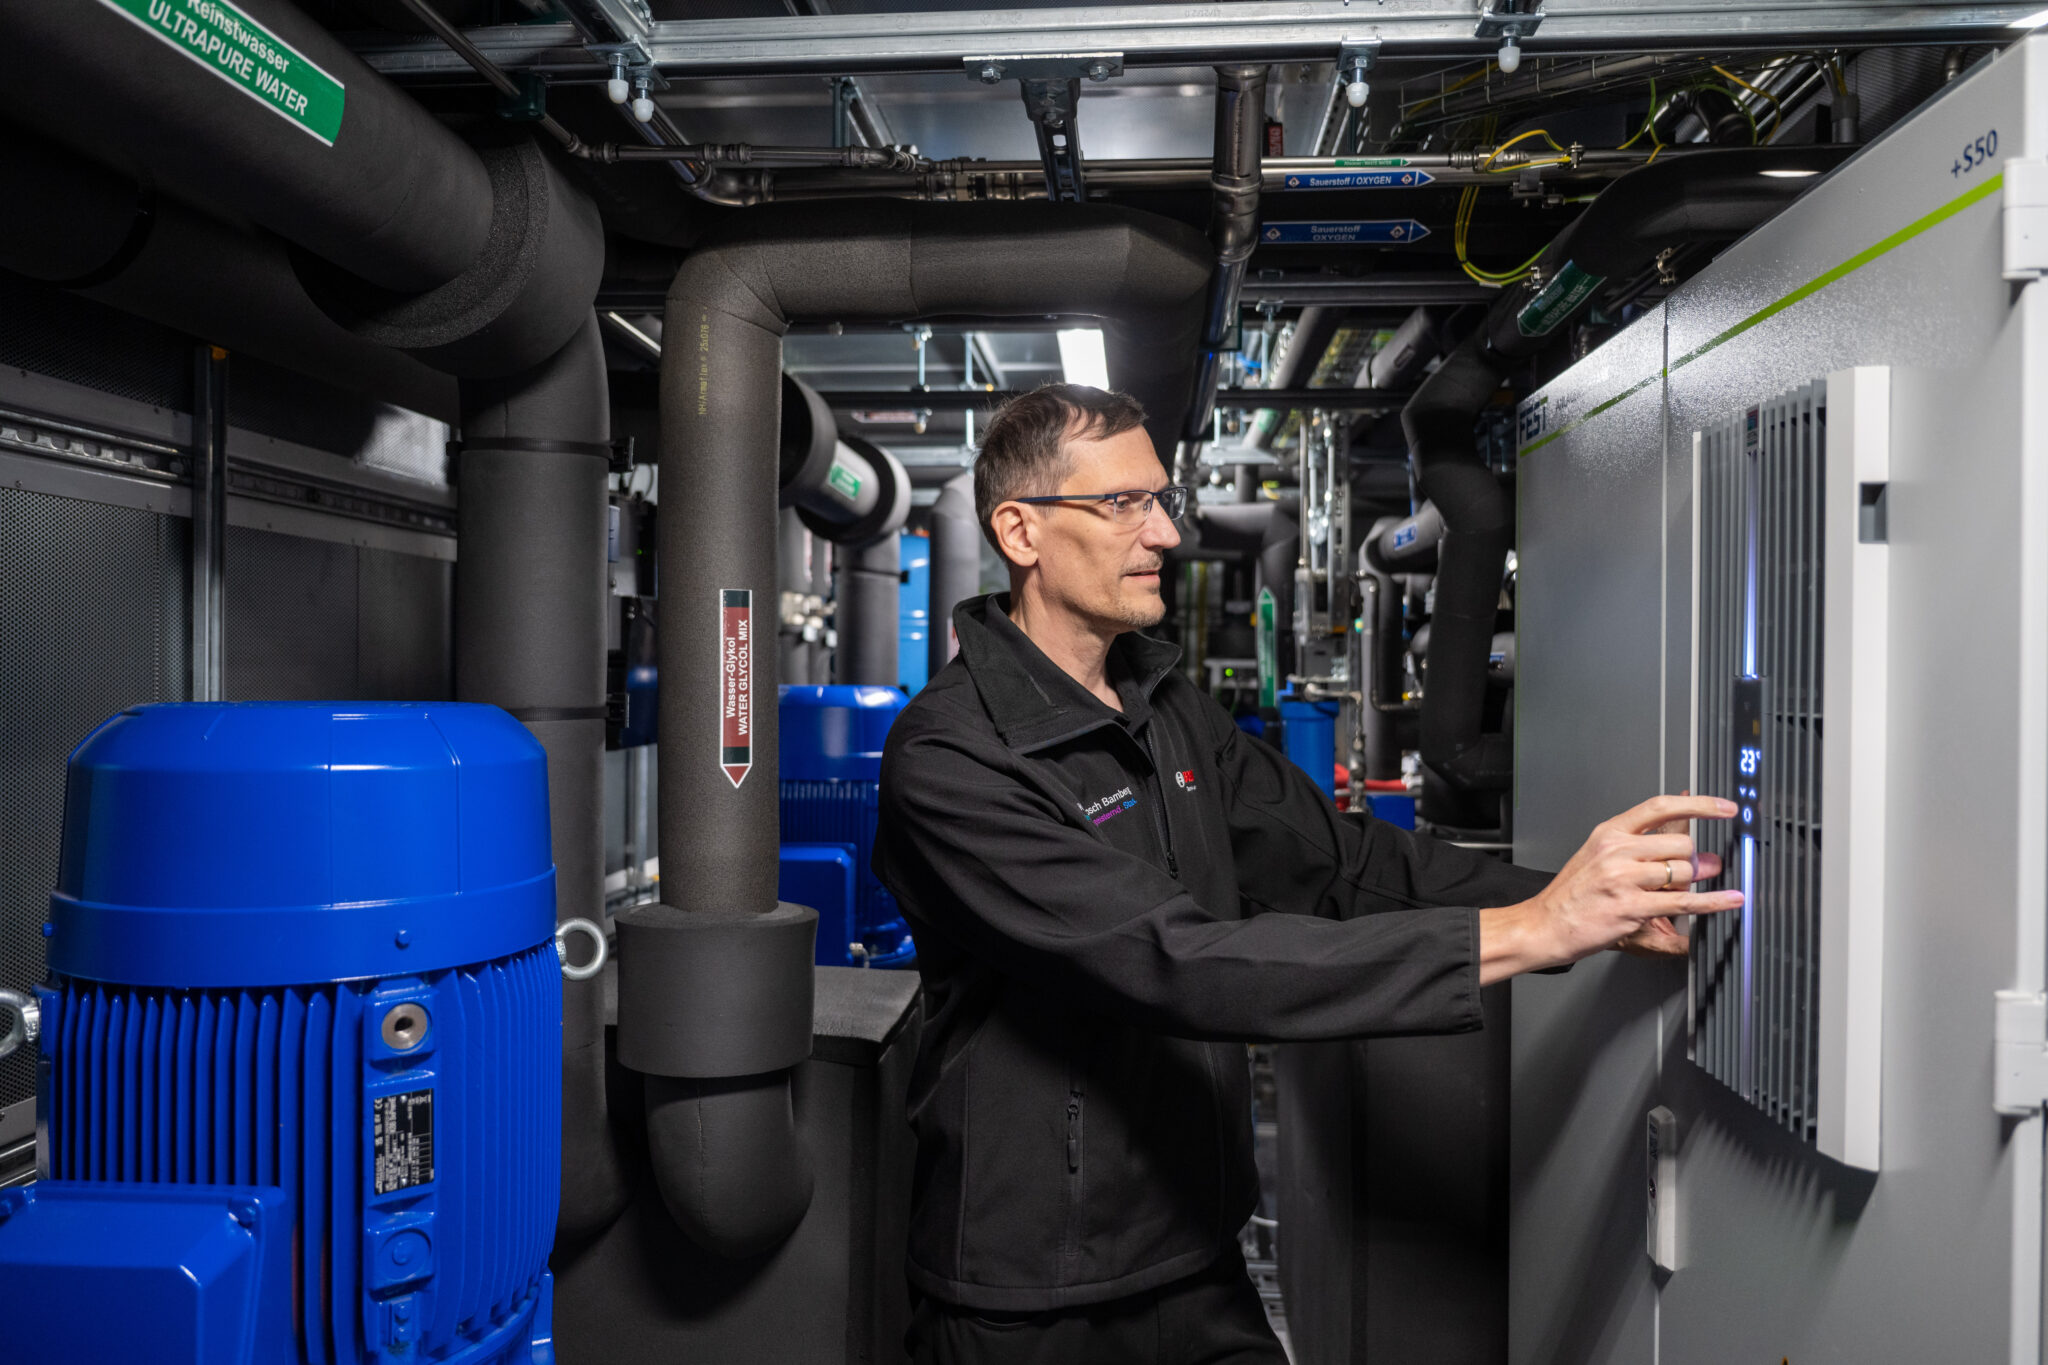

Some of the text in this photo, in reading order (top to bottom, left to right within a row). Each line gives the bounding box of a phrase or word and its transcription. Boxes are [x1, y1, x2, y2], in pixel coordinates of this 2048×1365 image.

[148, 0, 309, 116] ULTRAPURE WATER
[1309, 177, 1350, 186] Sauerstoff
[1356, 175, 1392, 185] OXYGEN
[1950, 129, 1998, 178] +S50
[1311, 225, 1361, 234] Sauerstoff
[726, 636, 738, 719] Wasser-Glykol
[738, 619, 748, 736] WATER GLYCOL MIX
